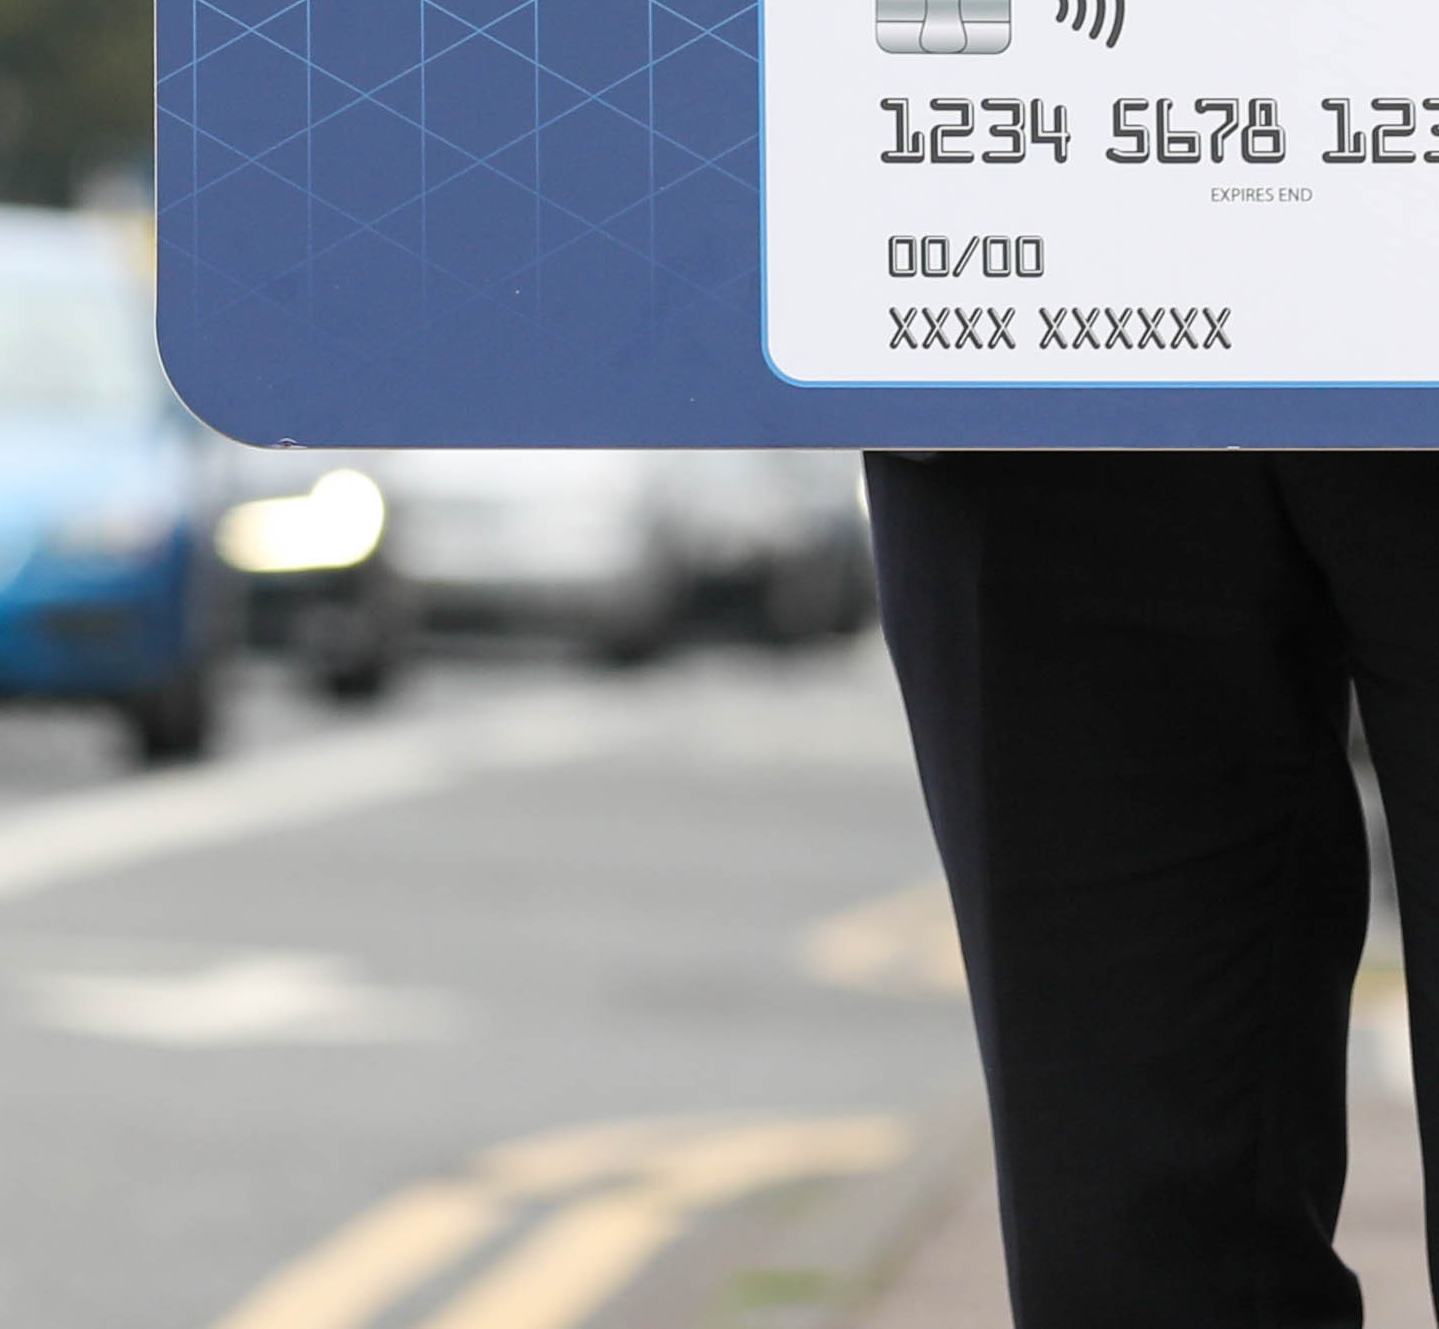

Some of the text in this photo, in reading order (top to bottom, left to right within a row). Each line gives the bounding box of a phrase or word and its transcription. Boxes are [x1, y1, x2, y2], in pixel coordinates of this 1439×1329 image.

[879, 97, 1072, 165] 1234
[1105, 97, 1286, 165] 5678
[1210, 187, 1313, 203] EXPIRES END
[887, 235, 1045, 278] 00/00
[888, 307, 1232, 350] XXXX XXXXXX
